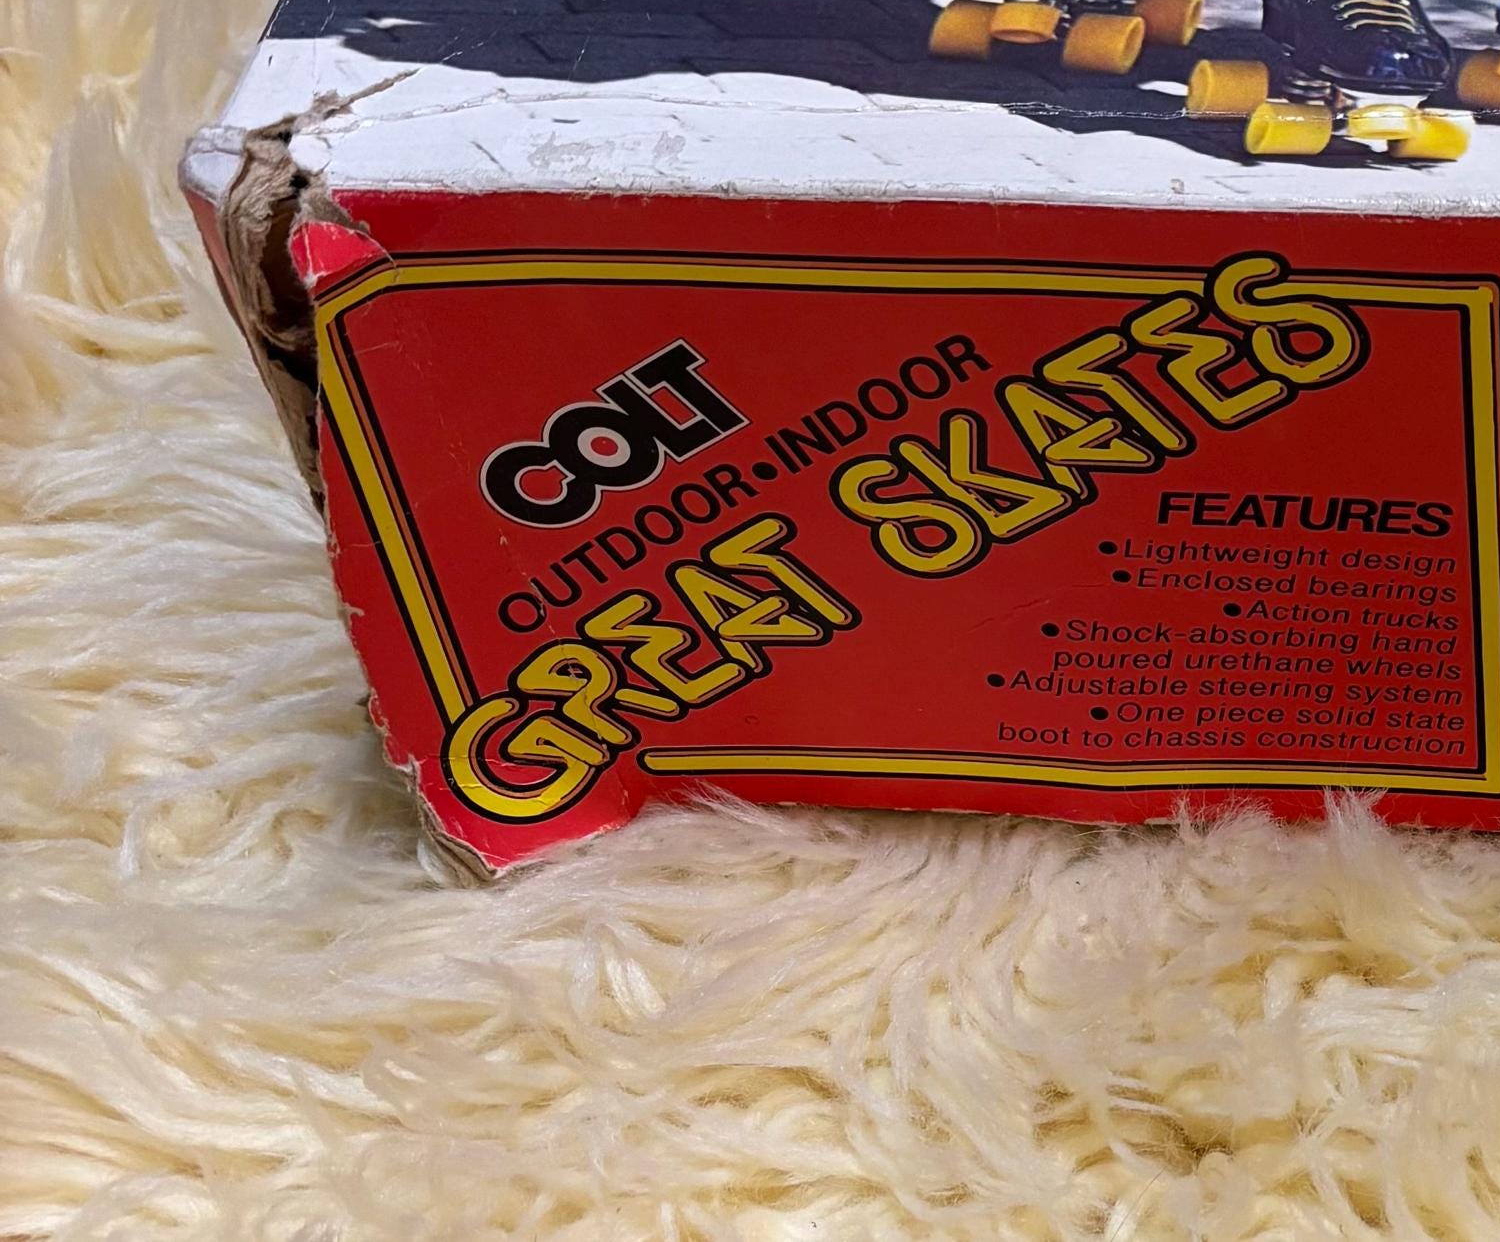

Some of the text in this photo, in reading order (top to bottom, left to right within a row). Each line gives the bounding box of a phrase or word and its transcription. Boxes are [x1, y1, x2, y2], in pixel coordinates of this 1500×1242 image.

[482, 338, 752, 528] COLT
[497, 334, 994, 634] OUTDOOR INDOOR
[1157, 491, 1454, 537] FEATURES
[440, 250, 1370, 824] GREAT SKATES
[1123, 538, 1457, 577] Lightweight design
[1137, 568, 1458, 606] Enclosed bearings
[1246, 599, 1459, 631] Action trucks
[1065, 619, 1457, 655] Shock-absorbing hand
[1053, 648, 1462, 680] poured urethane wheels
[1010, 669, 1463, 706] Adjustable steering system
[1117, 701, 1465, 732] One piece solid state
[998, 721, 1466, 755] boot to chassis construction
